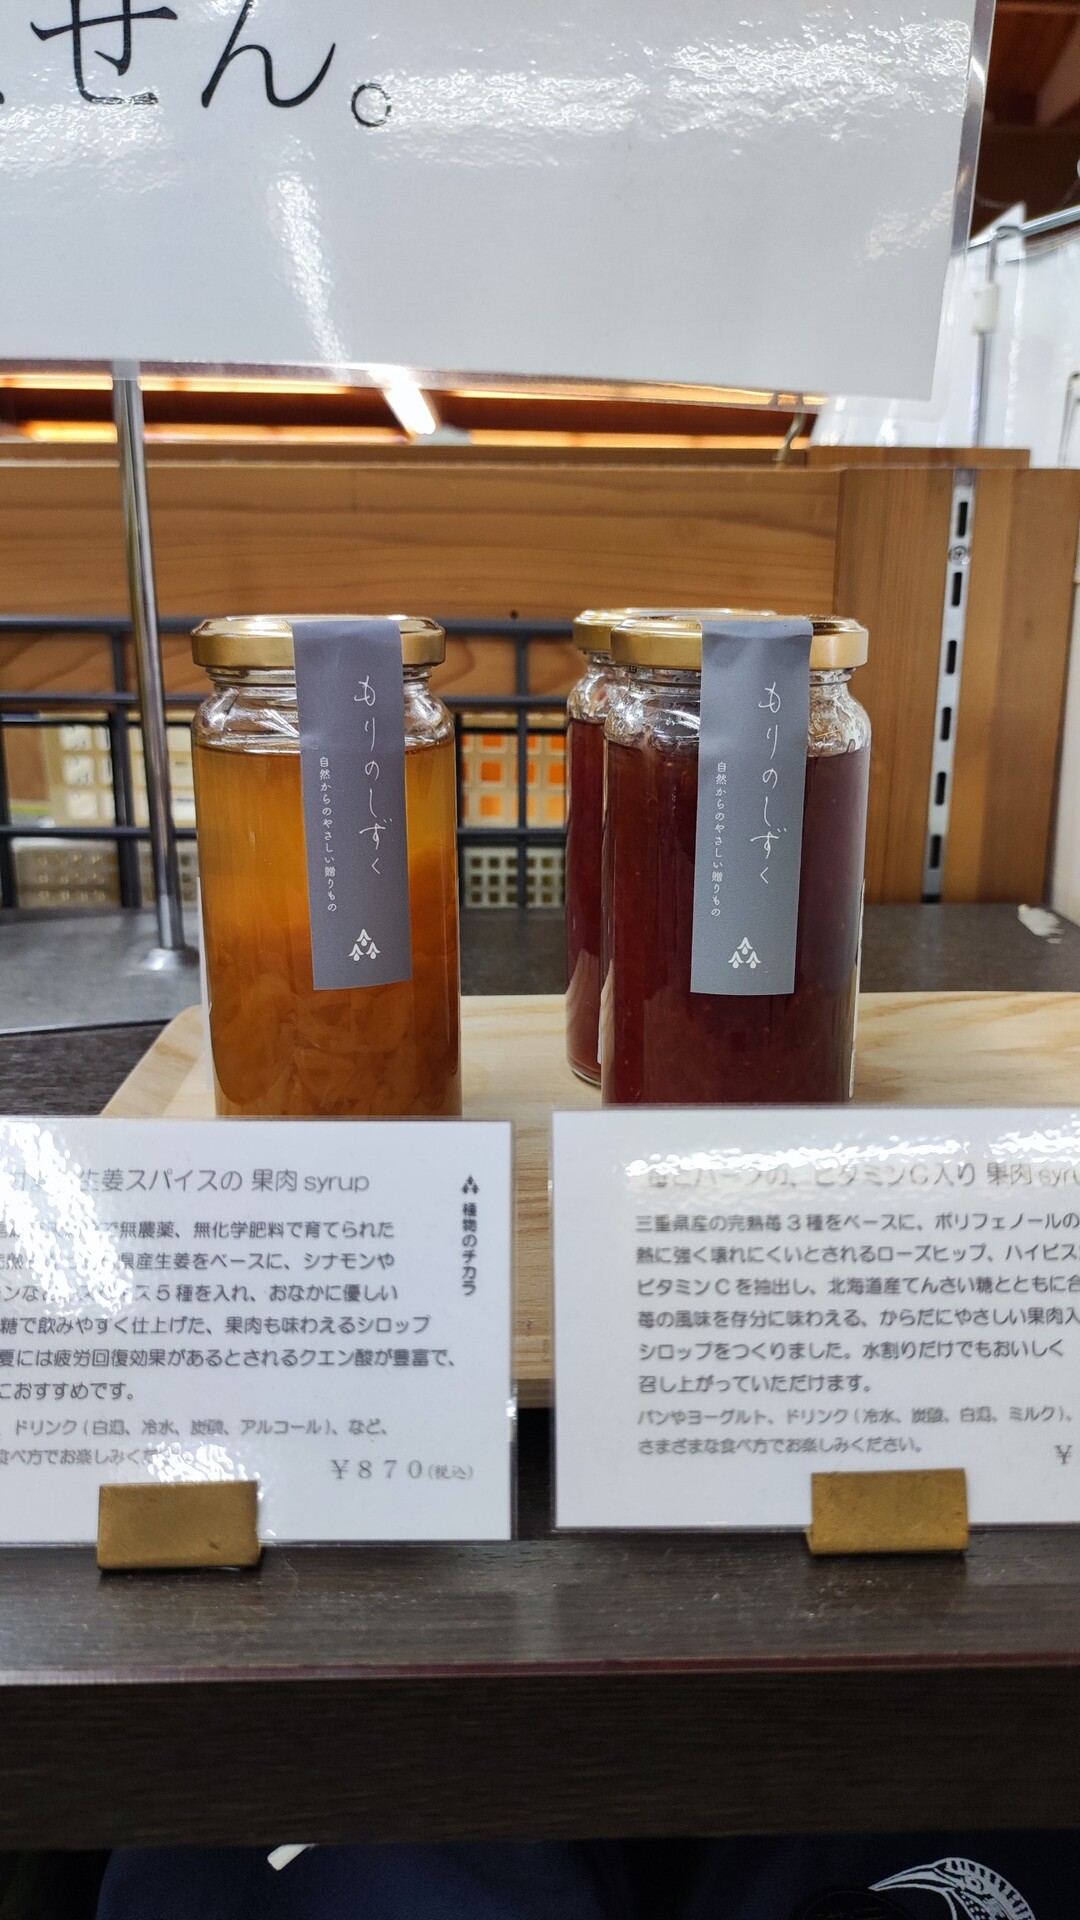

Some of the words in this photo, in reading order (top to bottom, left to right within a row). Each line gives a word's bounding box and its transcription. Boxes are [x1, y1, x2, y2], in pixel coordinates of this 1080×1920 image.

[319, 756, 338, 913] 自然からのやさしい贈りもの
[353, 675, 393, 876] もりのしずく
[710, 761, 728, 918] 自然からのやさしい贈りもの
[750, 682, 788, 885] もりのしずく
[303, 1175, 370, 1195] syrup
[635, 1242, 1080, 1266] 熱に強く壊れにくいとされるローズヒップ、ハイビス
